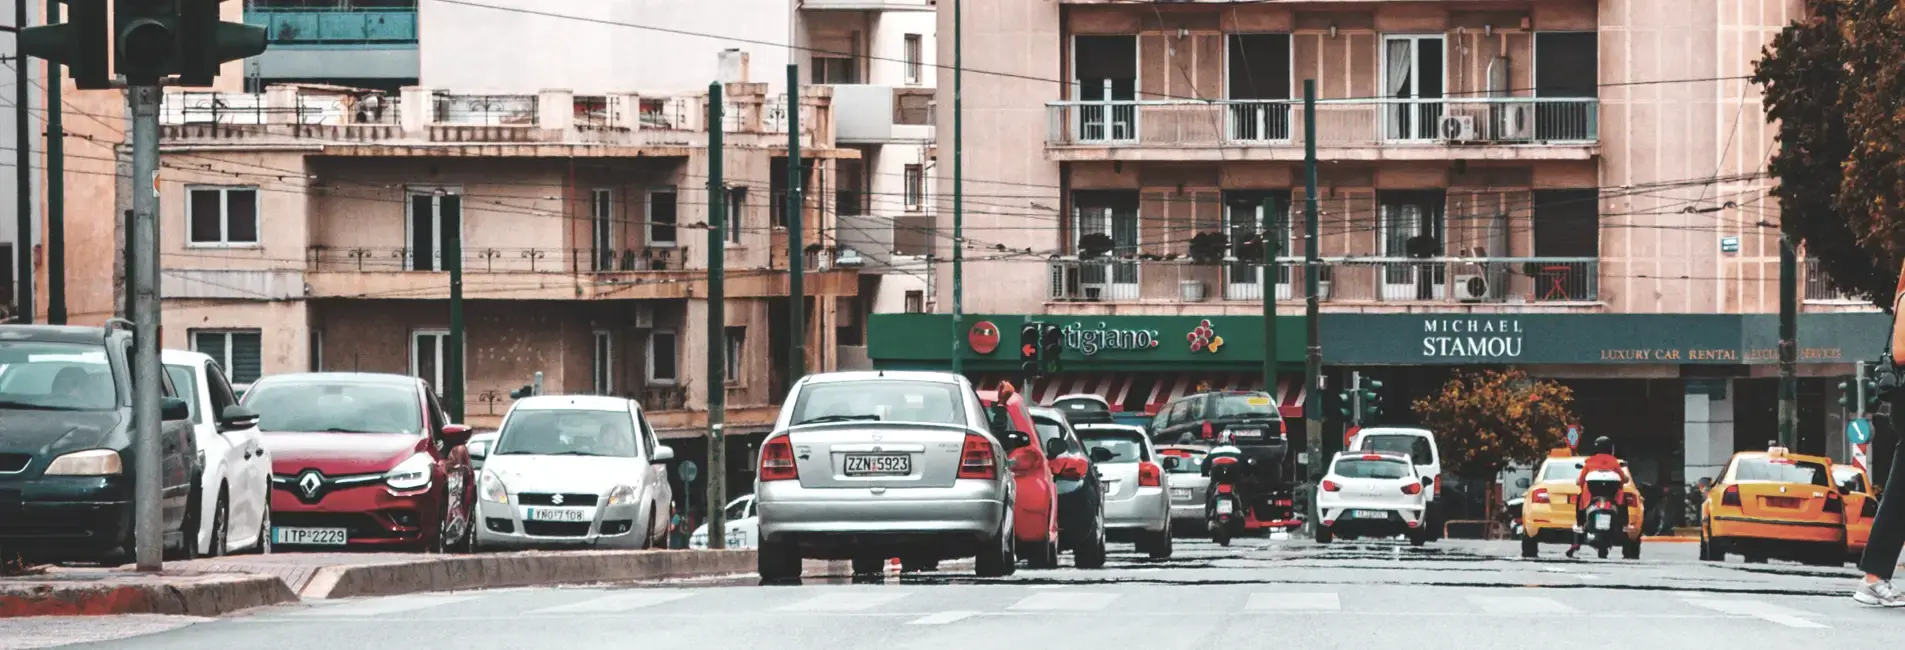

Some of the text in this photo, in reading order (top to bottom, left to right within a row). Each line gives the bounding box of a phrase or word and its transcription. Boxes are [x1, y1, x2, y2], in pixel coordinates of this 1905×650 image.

[1424, 319, 1523, 333] MICHAEL
[1423, 336, 1523, 357] STAMOU
[1600, 349, 1651, 360] LUXURY
[1654, 349, 1681, 360] CAR
[1688, 349, 1738, 360] RENTAL
